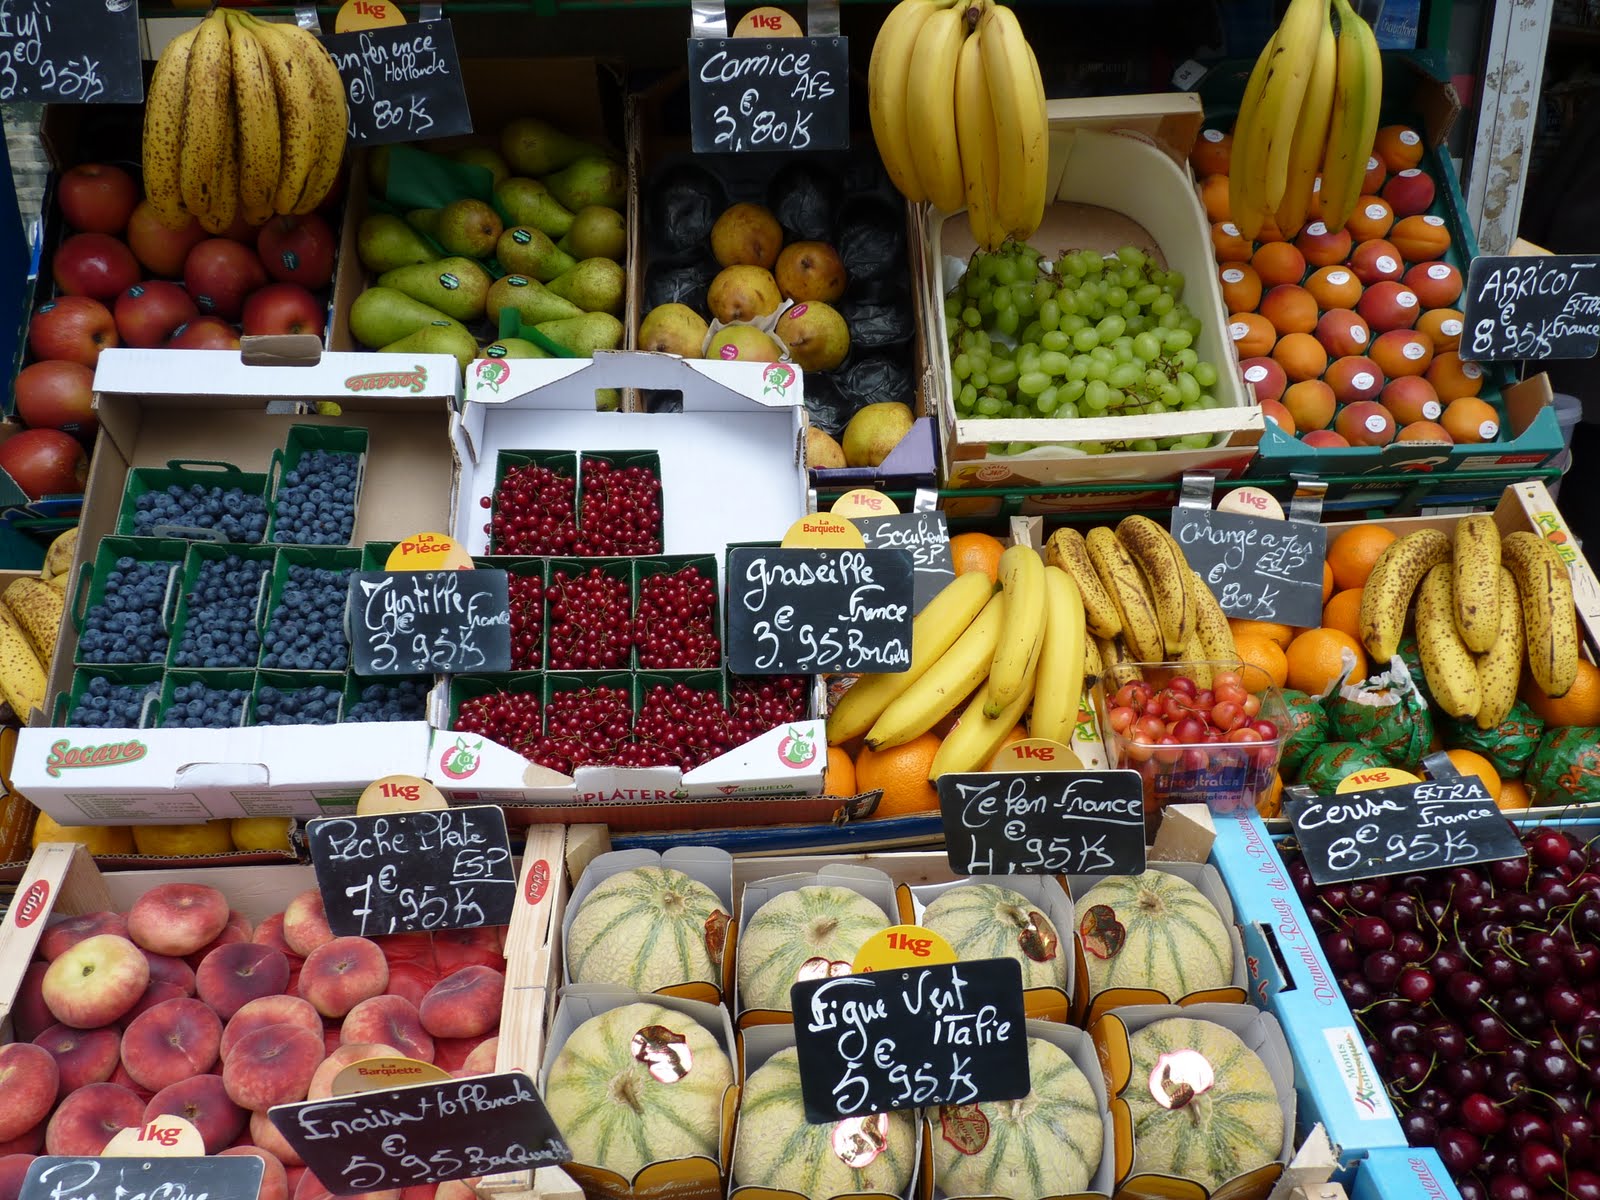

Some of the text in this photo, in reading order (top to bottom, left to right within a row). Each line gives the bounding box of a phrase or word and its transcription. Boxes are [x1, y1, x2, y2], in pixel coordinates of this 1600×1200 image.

[354, 2, 386, 19] 1kg
[750, 15, 782, 30] 1kg
[700, 48, 811, 83] Comice
[1478, 263, 1597, 309] ABRICOT
[851, 494, 883, 511] 1kg
[1238, 491, 1268, 510] 1kg
[803, 524, 845, 535] Barquette
[418, 534, 434, 543] La
[401, 542, 451, 556] Pièce
[46, 738, 148, 777] Socave
[1013, 745, 1055, 761] 1kg
[1350, 771, 1391, 786] 1kg
[379, 783, 420, 801] 1kg
[1298, 784, 1482, 830] Cerise EXTRA
[452, 847, 509, 878] ESP
[1259, 861, 1277, 875] la
[1267, 877, 1287, 891] de
[887, 932, 933, 957] 1kg
[1271, 897, 1336, 1006] Diamant Rouge
[1337, 1043, 1358, 1079] Monts
[358, 1066, 423, 1077] Barquette
[137, 1124, 182, 1146] 1kg
